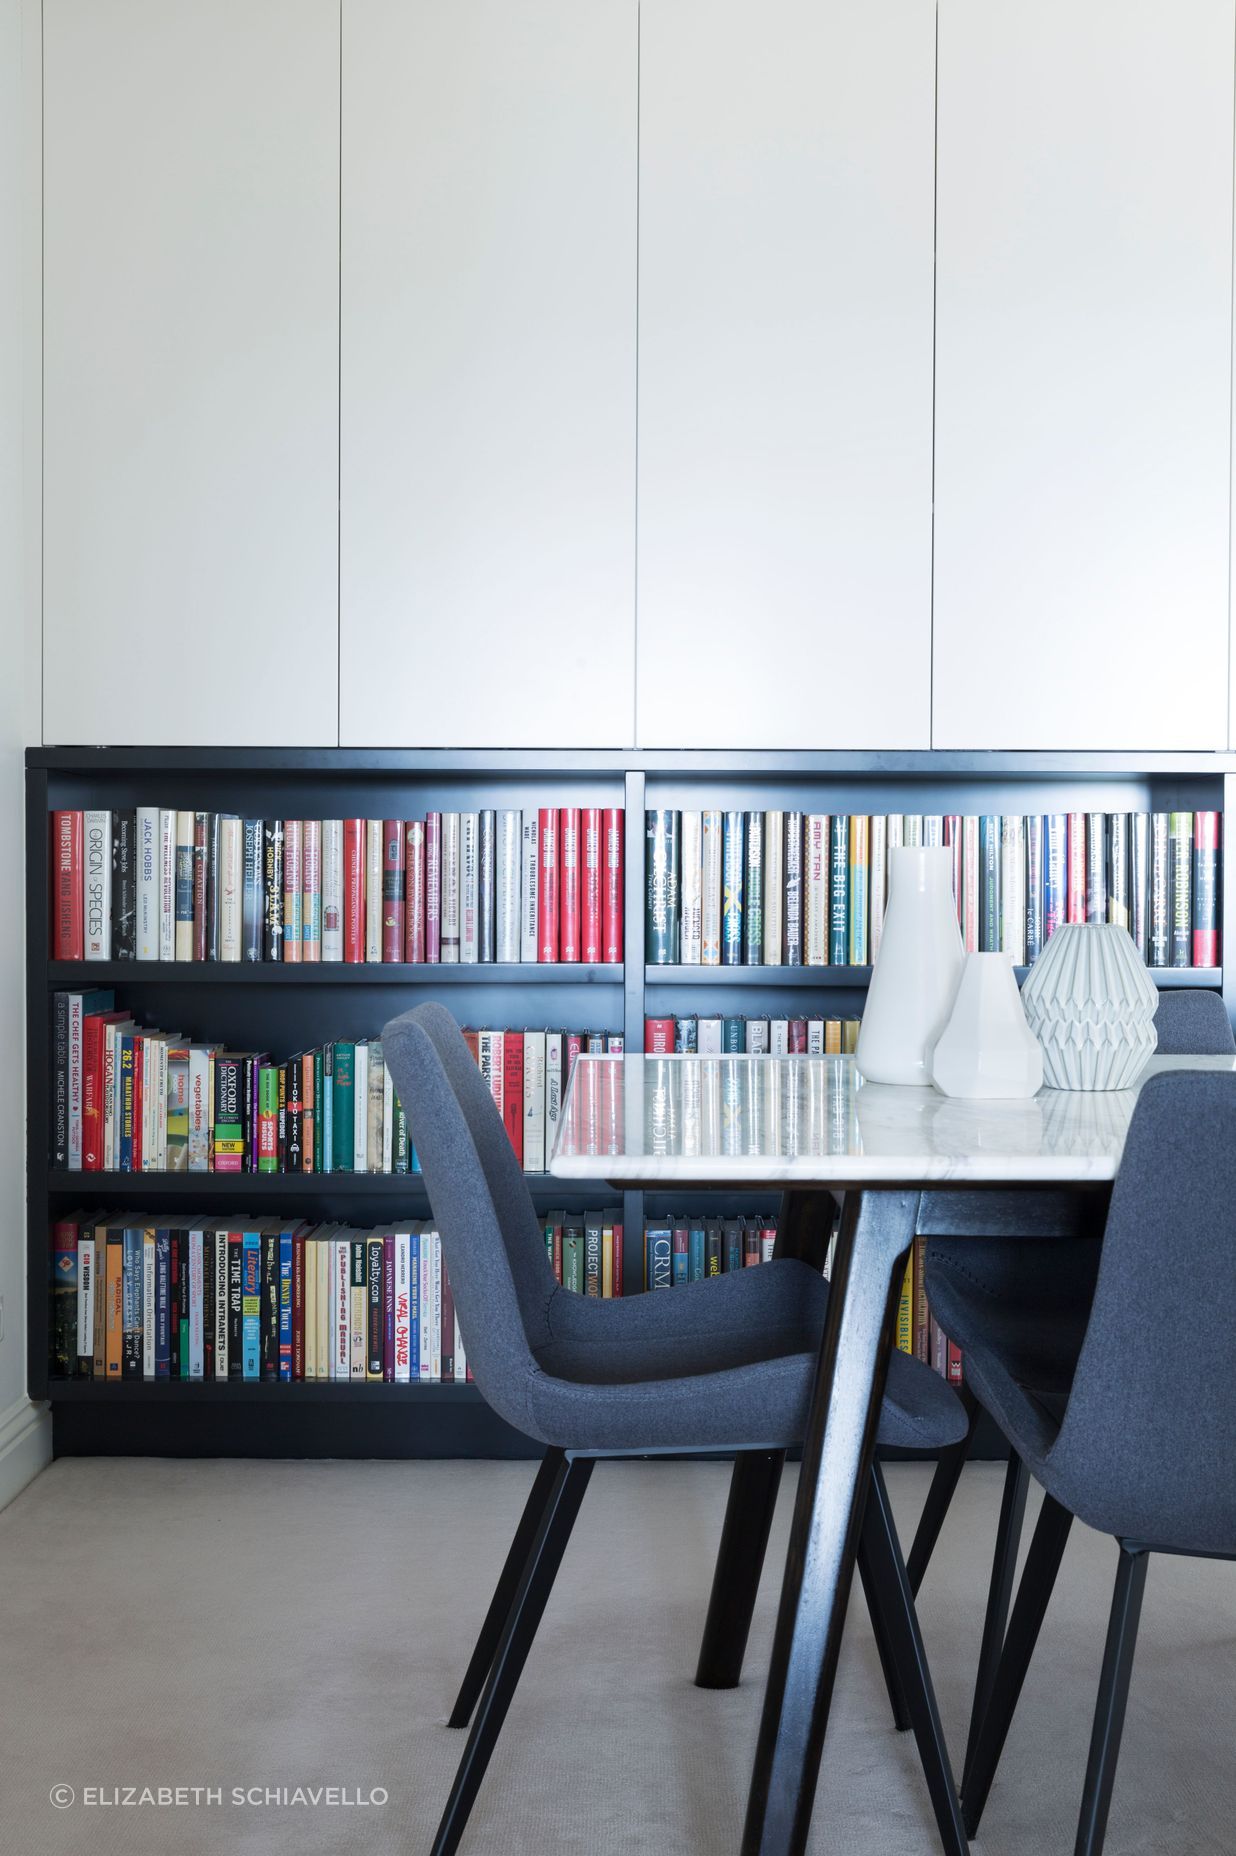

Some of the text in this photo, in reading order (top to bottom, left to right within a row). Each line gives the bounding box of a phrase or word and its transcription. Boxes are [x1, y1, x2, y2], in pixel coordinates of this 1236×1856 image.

[61, 815, 72, 871] TOMBSTONE
[89, 828, 103, 875] ORIGIN
[120, 820, 128, 873] Becoming Steve Jobs
[144, 818, 152, 882] JACK HOBBS
[245, 824, 254, 900] JOSEPH HELLER
[287, 824, 299, 892] NICK HORNBY
[306, 824, 318, 892] NICK HORNBY
[269, 885, 280, 926] SLAM
[667, 872, 677, 908] ADAM
[833, 844, 846, 932] THE BIG EXIT
[1176, 864, 1189, 928] ROBINSON
[89, 884, 103, 936] SPECIES
[748, 908, 761, 946] CROSS
[787, 891, 800, 946] BELINDA BAUER
[56, 1009, 67, 1039] simple
[482, 1036, 491, 1053] THE
[654, 1032, 666, 1053] HIRO
[811, 1031, 820, 1043] THE
[58, 1042, 67, 1065] table
[105, 1050, 114, 1084] HOGAN
[122, 1050, 132, 1069] 26.2
[492, 1036, 502, 1072] ROBERT
[178, 1074, 186, 1104] home
[194, 1074, 203, 1132] vegetables
[228, 1066, 237, 1113] OXFORD
[132, 1265, 140, 1281] Says
[231, 1259, 241, 1284] TIME
[244, 1250, 258, 1294] Literary
[281, 1261, 292, 1277] THE
[368, 1246, 381, 1302] loyalty.com
[654, 1240, 671, 1288] CRM
[132, 1282, 140, 1316] Elephants
[231, 1286, 241, 1312] TRAP
[281, 1278, 291, 1305] DISNEY
[397, 1292, 408, 1366] VIRAL CHANGE
[900, 1295, 909, 1350] INVISIBLES
